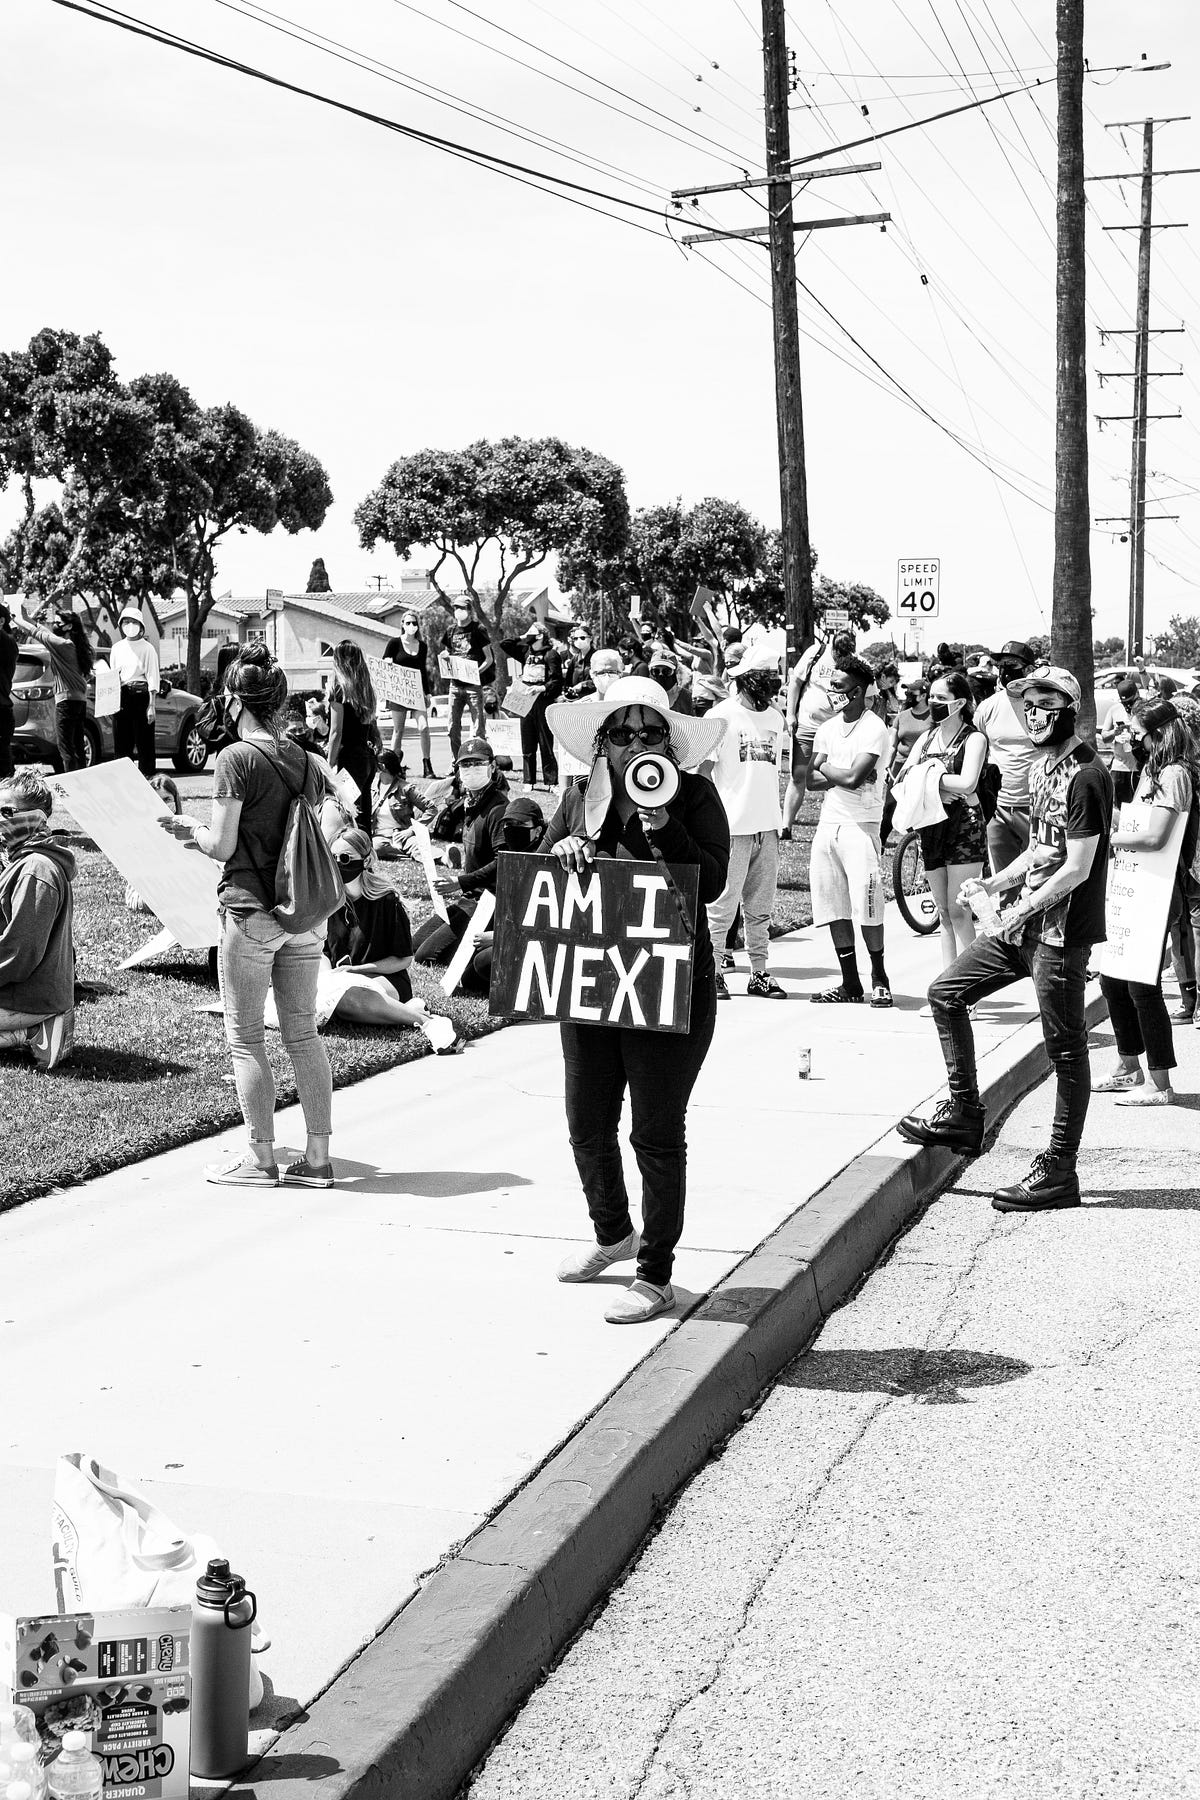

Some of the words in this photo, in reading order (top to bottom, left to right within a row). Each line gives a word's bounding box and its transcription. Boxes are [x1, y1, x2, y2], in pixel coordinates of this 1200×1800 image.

[900, 564, 938, 573] SPEED
[903, 577, 934, 587] LIMIT
[900, 591, 936, 612] 40
[521, 870, 604, 935] AM
[626, 874, 671, 939] I
[513, 940, 692, 1027] NEXT
[102, 1742, 122, 1752] PACK
[121, 1738, 152, 1750] VARIETY
[104, 1786, 146, 1799] QUAKER
